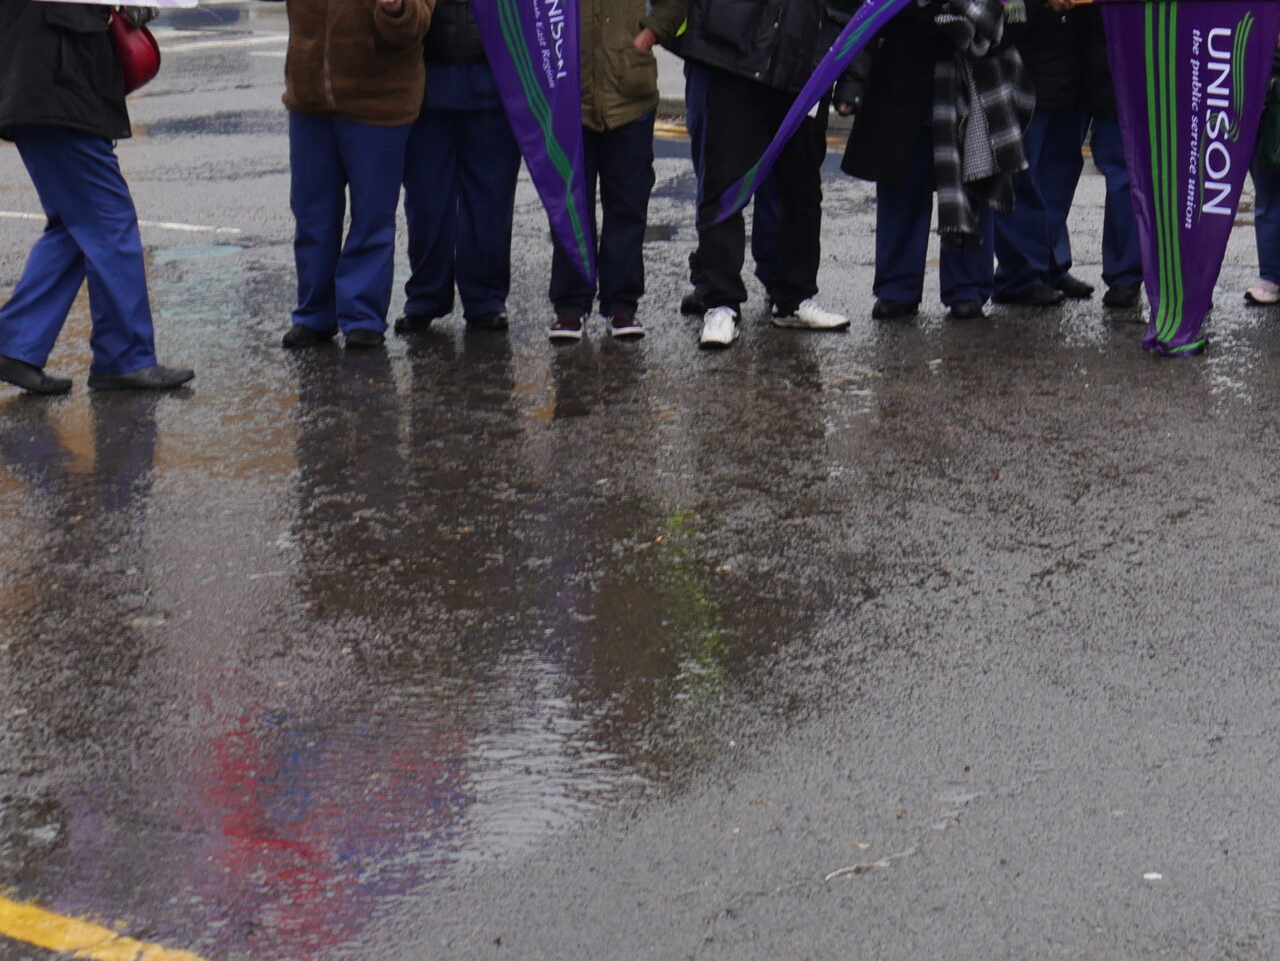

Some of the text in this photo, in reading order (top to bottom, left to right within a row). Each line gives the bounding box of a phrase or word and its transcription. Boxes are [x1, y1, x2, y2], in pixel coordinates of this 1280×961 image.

[1185, 28, 1203, 229] the public service union
[1202, 27, 1232, 215] UNISON
